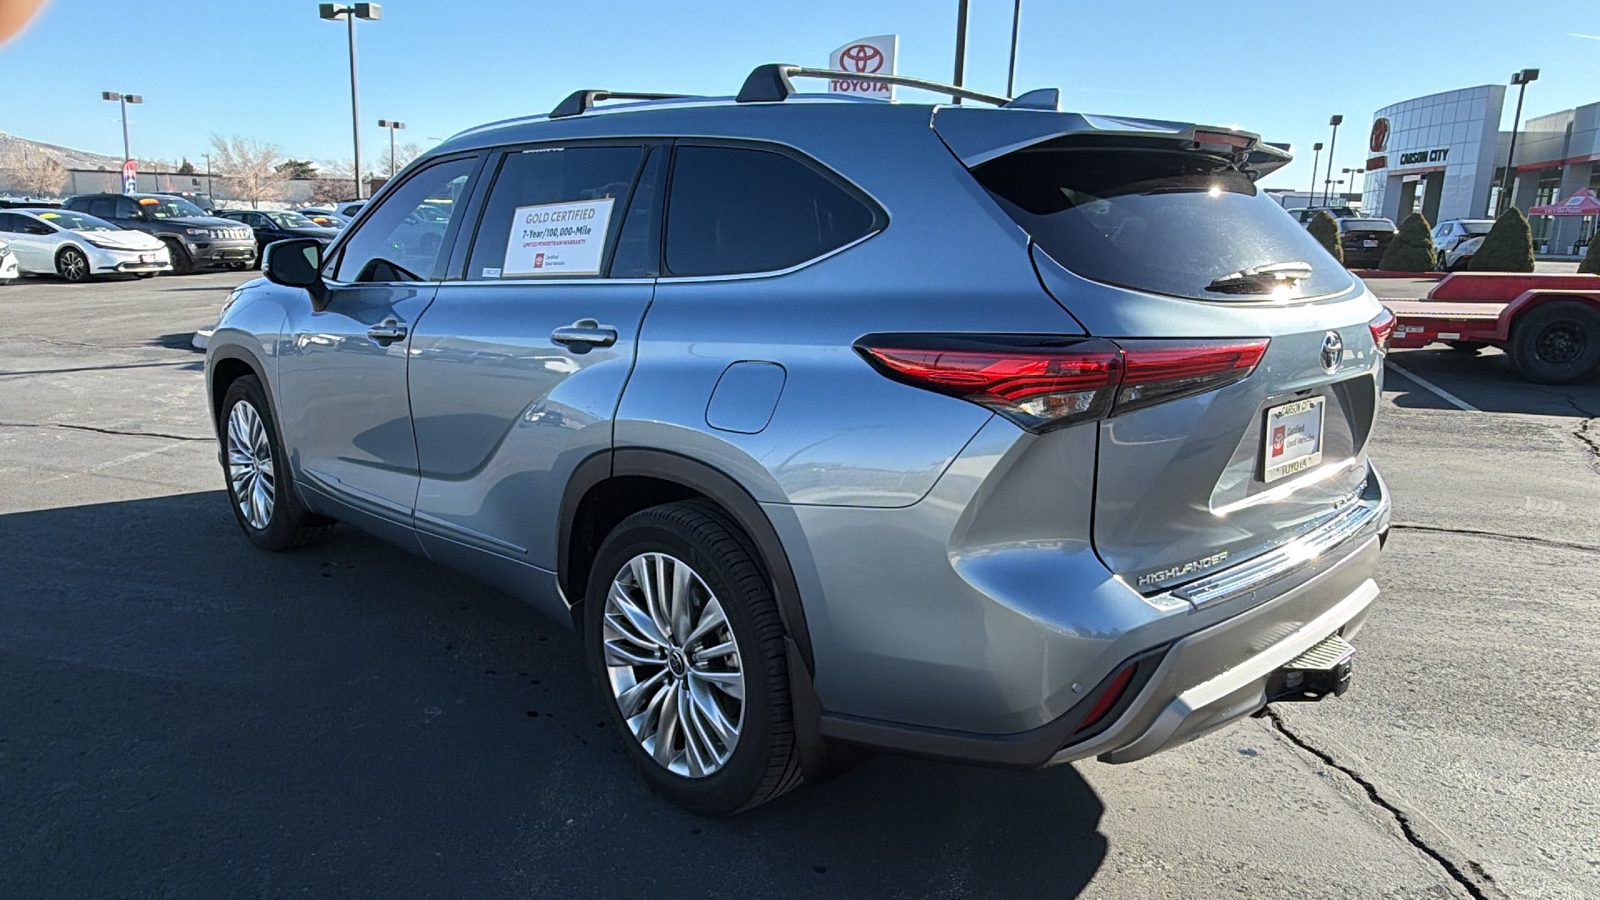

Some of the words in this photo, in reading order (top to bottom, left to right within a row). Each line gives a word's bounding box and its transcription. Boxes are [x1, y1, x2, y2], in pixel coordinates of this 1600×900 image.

[831, 80, 889, 92] TOYOTA
[1400, 151, 1428, 165] CARSON
[1429, 148, 1449, 162] CITY
[526, 212, 550, 224] GOLD
[550, 208, 596, 222] CERTIFIED
[522, 225, 592, 239] 7-Year/100,000-Mile
[1287, 423, 1305, 436] Certified
[1286, 439, 1297, 448] Used
[1281, 459, 1307, 475] TOYOTA
[1137, 551, 1228, 586] HIGHLANDER
